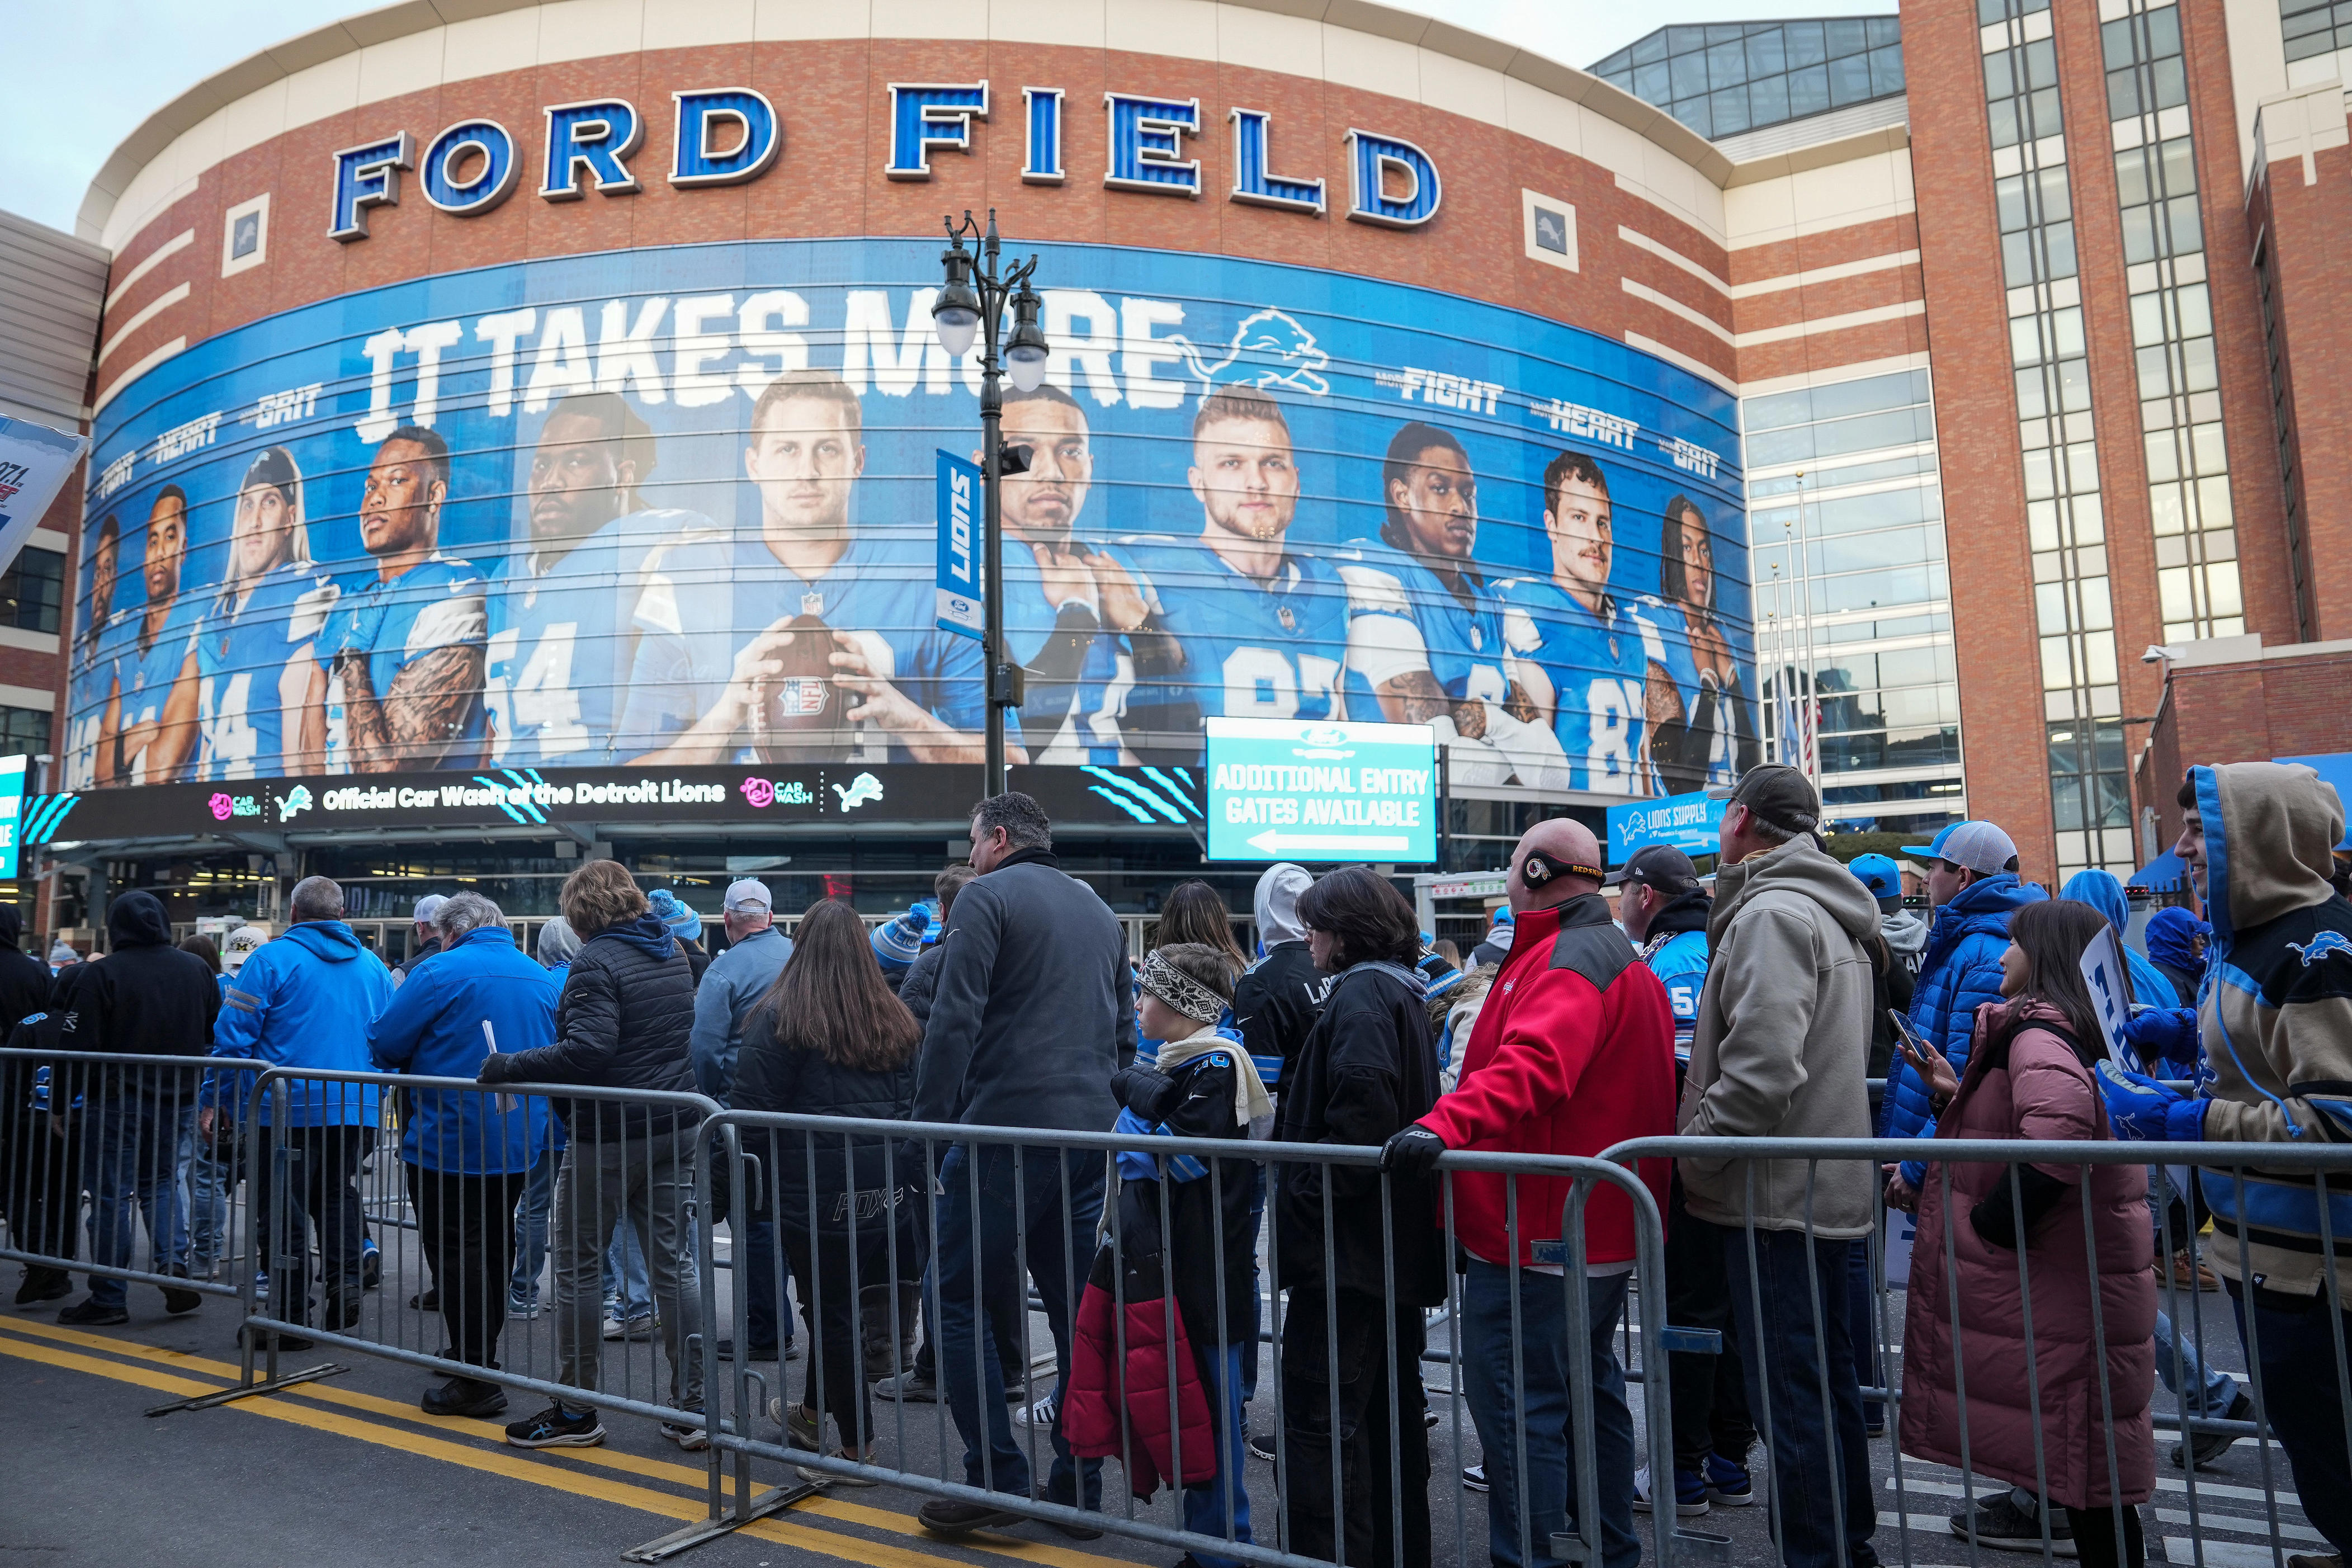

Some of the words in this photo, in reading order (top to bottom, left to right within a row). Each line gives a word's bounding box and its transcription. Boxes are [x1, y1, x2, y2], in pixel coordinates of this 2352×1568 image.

[327, 86, 785, 244] FORD
[884, 79, 1443, 228] FIELD
[353, 319, 464, 445] IT
[474, 289, 811, 417] TAKES
[841, 287, 1188, 410] MRE
[256, 381, 323, 429] GRIT
[1401, 366, 1505, 415] FIGHT
[1550, 398, 1641, 450] HEART
[1673, 436, 1721, 480] GRIT
[951, 466, 971, 584] LIONS
[802, 681, 821, 711] NFL
[323, 786, 396, 810] Official
[398, 787, 438, 808] Car
[441, 784, 505, 807] Wash
[507, 782, 533, 806] of
[535, 783, 573, 805] the
[576, 779, 659, 804] Detroit
[662, 779, 725, 804] Lions
[774, 782, 803, 794] CAR
[1213, 763, 1357, 794] ADDITIONAL
[1360, 767, 1429, 795] ENTRY
[232, 796, 254, 806] CAR
[233, 805, 261, 816] WASH
[774, 792, 813, 804] WASH
[1225, 797, 1299, 825] GATES
[1302, 799, 1420, 828] AVAILABLE
[1647, 807, 1671, 830] LIONS
[1673, 802, 1707, 827] SUPPLY
[1572, 865, 1602, 878] REDSKINS
[230, 936, 257, 950] MICHIGAN
[893, 931, 920, 948] LION
[1380, 1140, 1392, 1165] saucony
[833, 1188, 887, 1221] FOX
